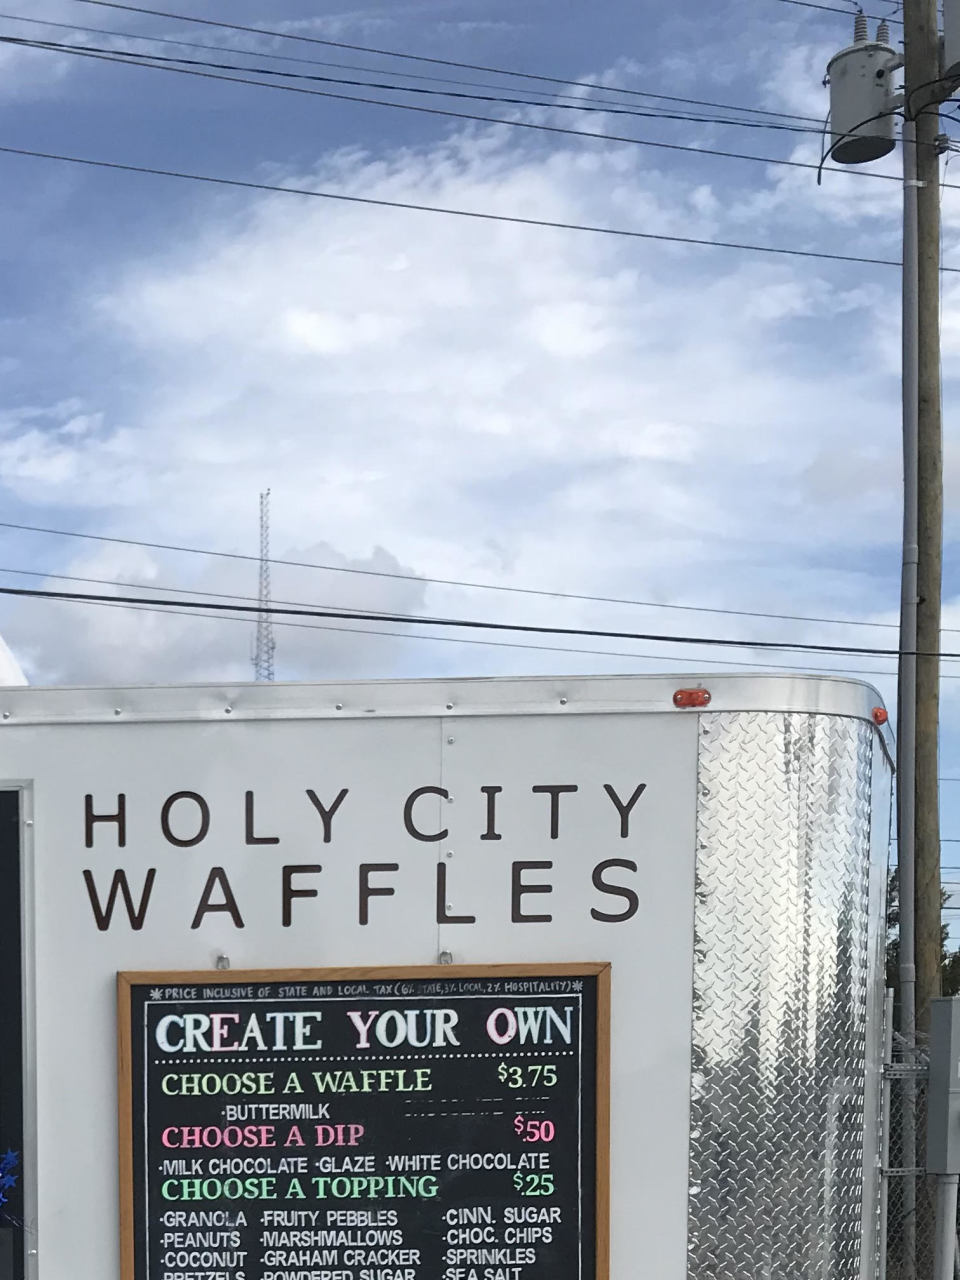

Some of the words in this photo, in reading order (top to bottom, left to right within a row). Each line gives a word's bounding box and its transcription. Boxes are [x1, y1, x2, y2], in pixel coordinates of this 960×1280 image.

[84, 788, 349, 848] HOLY
[403, 783, 647, 843] CITY
[82, 858, 640, 932] WAFFLES
[165, 988, 198, 999] PRICE
[203, 987, 254, 998] INCLUSIVE
[258, 987, 271, 998] OF
[278, 986, 307, 997] STATE
[313, 986, 333, 996] AND
[338, 985, 370, 996] LOCAL
[373, 984, 391, 994] TAX
[505, 980, 572, 992] HOSPITALITY)
[155, 1011, 323, 1053] CREATE
[346, 1009, 460, 1050] YOUR
[486, 1007, 573, 1045] OWN
[161, 1072, 275, 1096] CHOOSE
[283, 1072, 304, 1094] A
[312, 1068, 432, 1093] WAFFLE
[498, 1062, 558, 1088] $3.75
[226, 1103, 330, 1120] BUTTERMILK
[161, 1126, 276, 1148] CHOOSE
[284, 1125, 305, 1147] A
[315, 1124, 365, 1146] DIP
[514, 1115, 555, 1142] $.50
[163, 1159, 203, 1175] MILK
[209, 1157, 308, 1174] CHOCOLATE
[320, 1156, 375, 1173] GLAZE
[389, 1155, 441, 1171] WHITE
[447, 1153, 550, 1170] CHOCOLATE
[161, 1177, 277, 1201] CHOOSE
[284, 1178, 306, 1199] A
[312, 1175, 438, 1198] TOPPING
[513, 1171, 555, 1196] $.25
[163, 1211, 247, 1227] GRANOLA
[263, 1210, 320, 1227] FRUITY
[326, 1210, 398, 1227] PEBBLES
[446, 1207, 496, 1225] CINN.
[504, 1207, 561, 1224] SUGAR
[164, 1231, 241, 1248] PEANUTS
[264, 1230, 402, 1248] MARSHMALLOWS
[447, 1227, 499, 1245] CHOC.
[504, 1227, 553, 1244] CHIPS
[165, 1251, 247, 1268] COCONUT
[264, 1250, 338, 1266] GRAHAM
[344, 1249, 421, 1266] CRACKER
[446, 1248, 536, 1265] SPRINKLES
